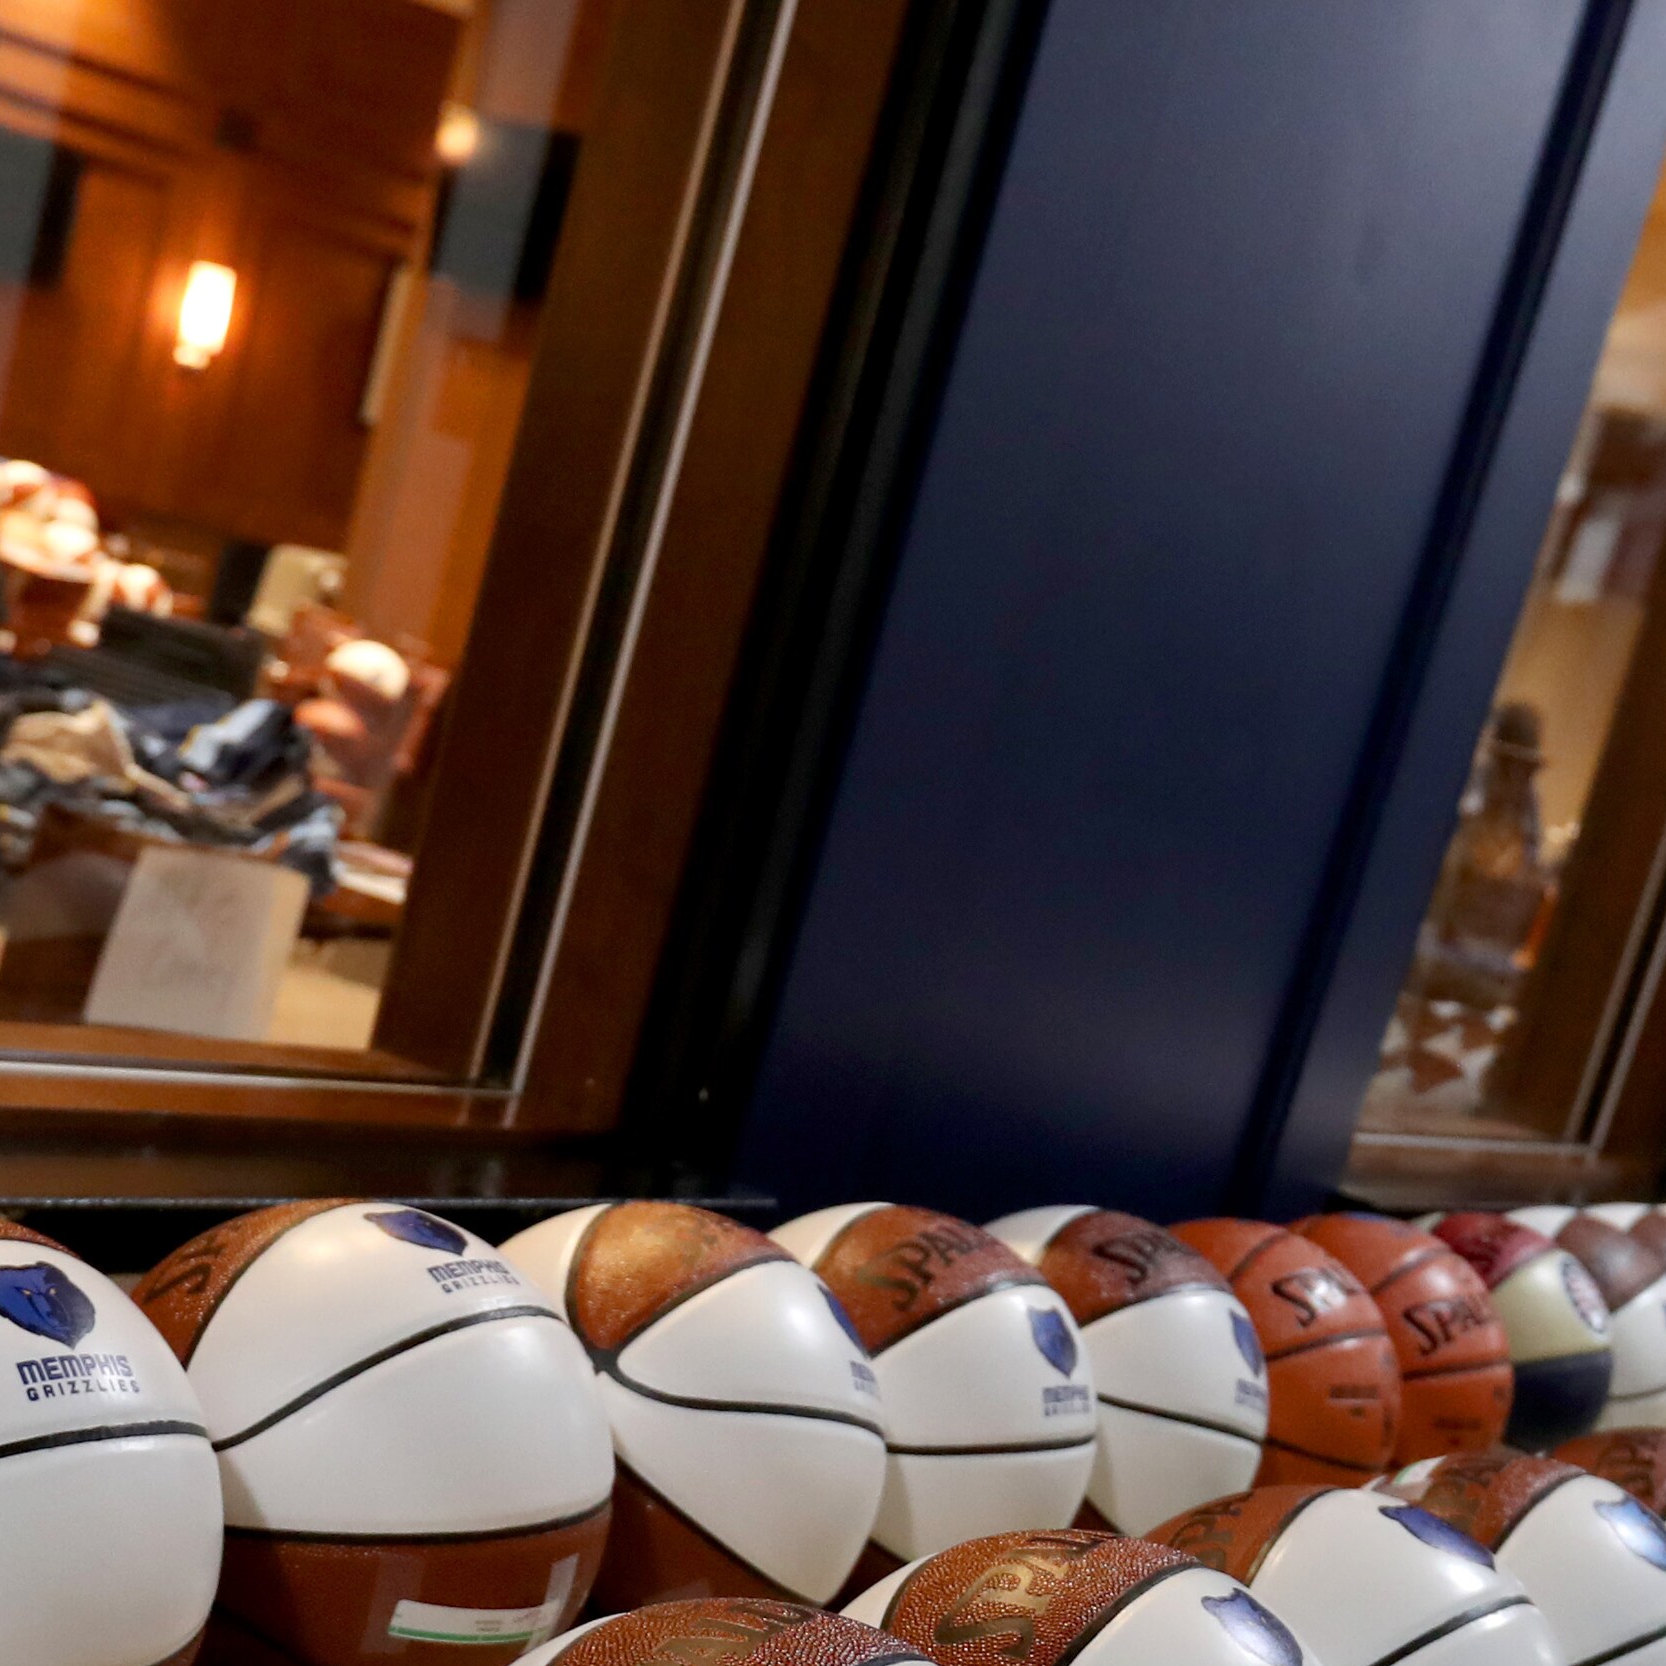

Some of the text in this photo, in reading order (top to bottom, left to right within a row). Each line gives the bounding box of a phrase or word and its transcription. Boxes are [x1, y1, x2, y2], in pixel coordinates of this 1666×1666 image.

[427, 1260, 510, 1282] MEMPHIS
[441, 1275, 520, 1293] GRIZZLIES
[16, 1353, 133, 1385] MEMPHIS
[26, 1379, 140, 1401] GRIZZLIES
